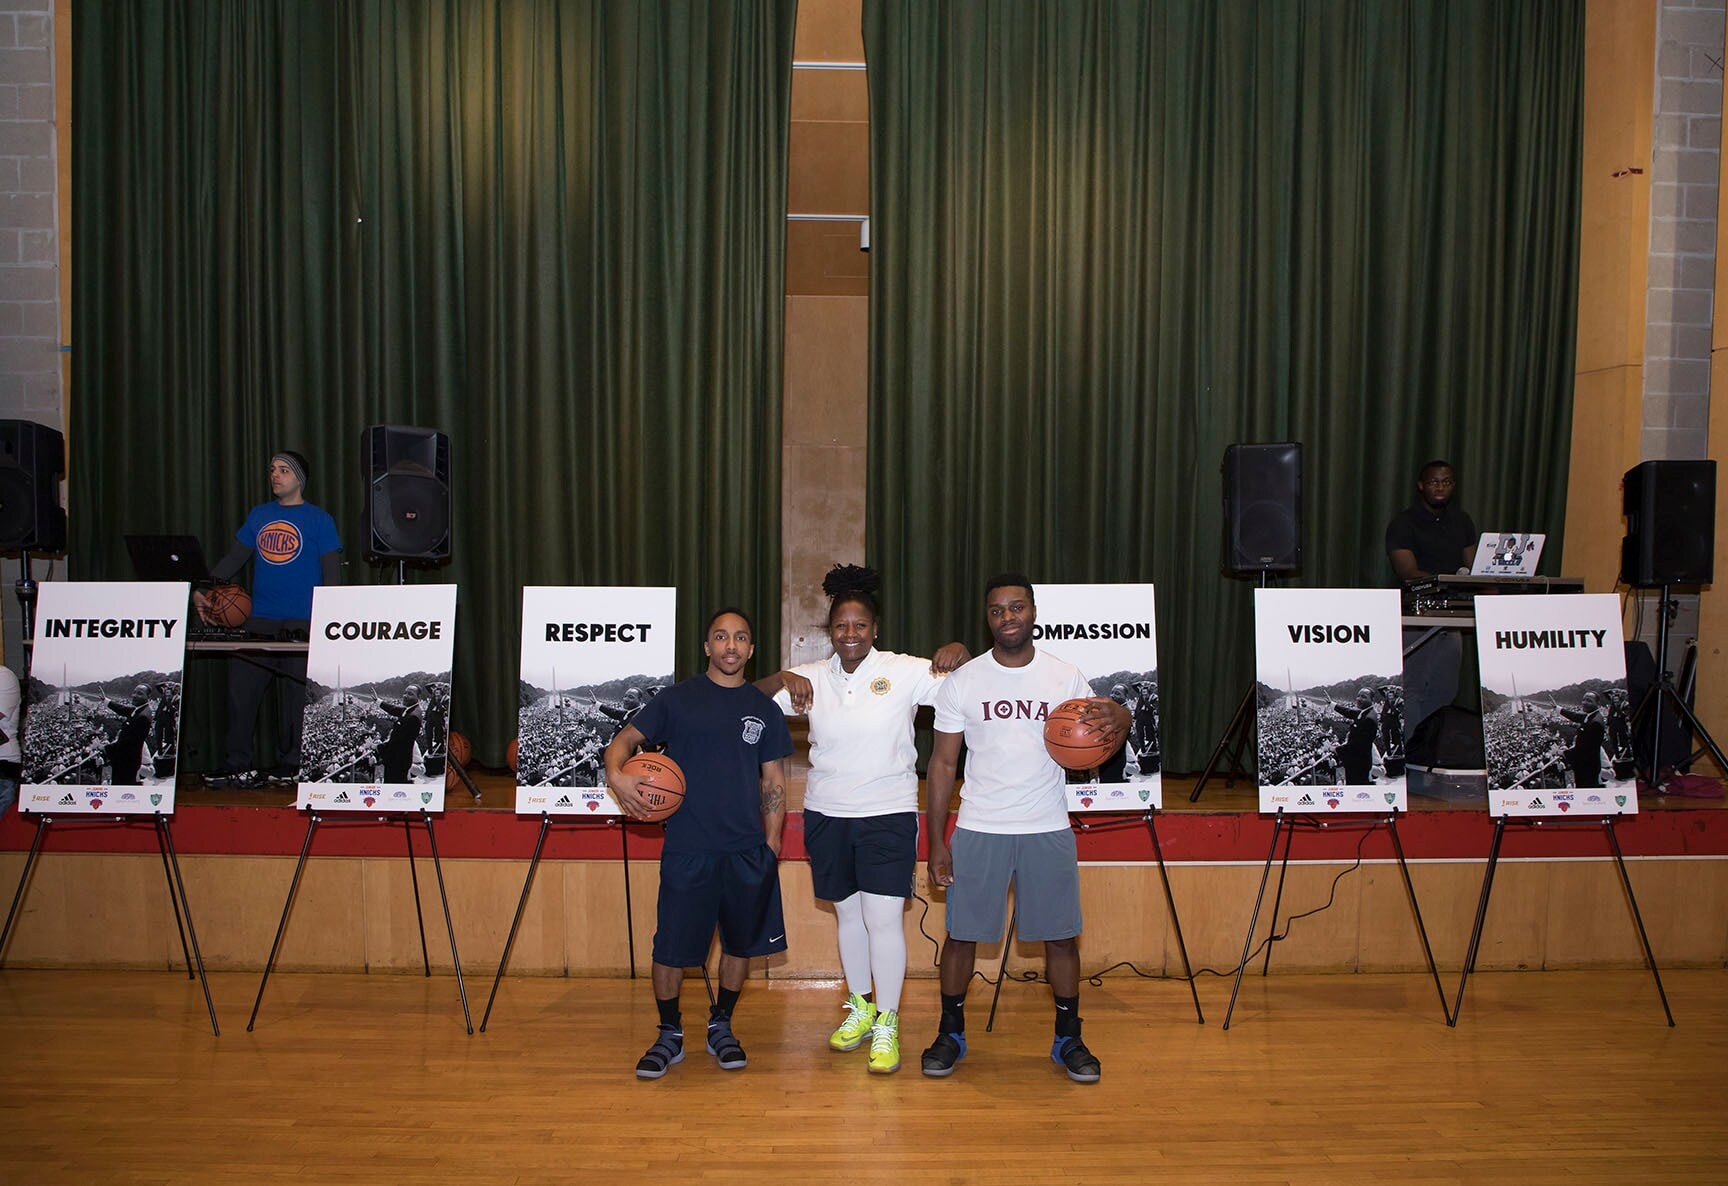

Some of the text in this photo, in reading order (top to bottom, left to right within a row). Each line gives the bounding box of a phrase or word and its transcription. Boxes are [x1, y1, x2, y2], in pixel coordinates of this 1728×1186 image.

[260, 532, 295, 551] KNICKS
[45, 618, 178, 639] INTEGRITY
[324, 621, 441, 641] COURAGE
[545, 623, 652, 643] RESPECT
[1032, 623, 1151, 640] OMPASSION
[1287, 624, 1371, 644] VISION
[1495, 629, 1607, 649] HUMILITY
[981, 700, 1049, 721] IONA
